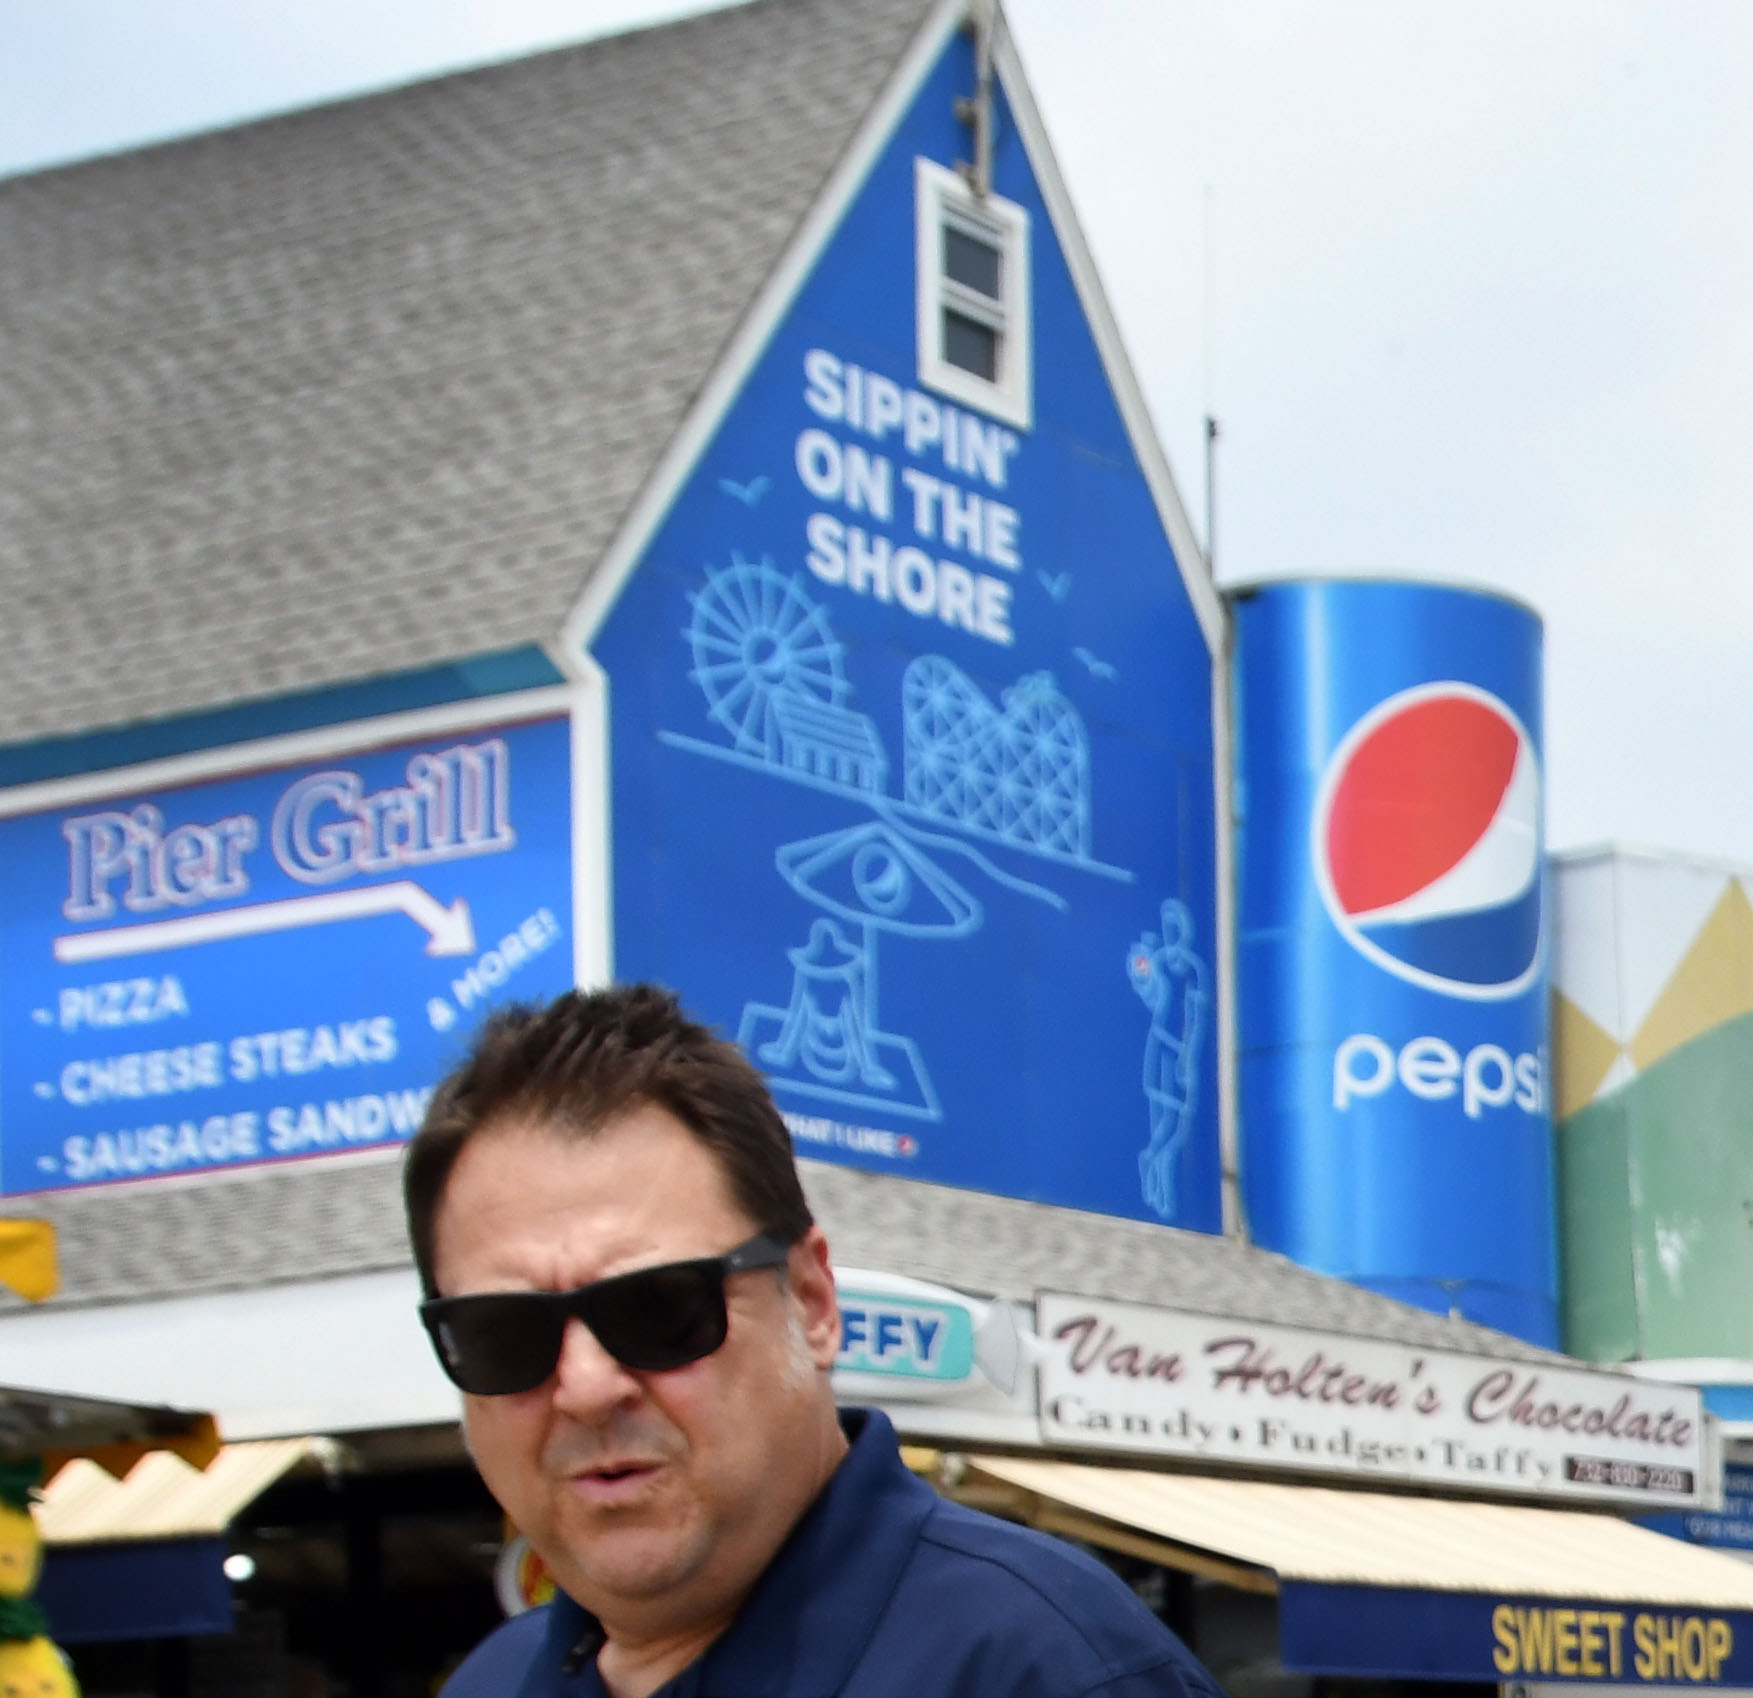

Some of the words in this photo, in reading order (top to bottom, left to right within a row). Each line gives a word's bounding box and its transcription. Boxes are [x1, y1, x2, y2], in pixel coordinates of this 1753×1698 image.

[803, 348, 1018, 488] SIPPIN'
[794, 428, 893, 521] ON
[902, 467, 1023, 571] THE
[805, 511, 1014, 646] SHORE
[62, 802, 259, 921] Pier
[271, 738, 516, 886] Grill
[58, 976, 189, 1031] PIZZA
[60, 1041, 224, 1107] CHEESE
[230, 1016, 398, 1081] STEAKS
[1332, 1033, 1542, 1119] peps
[64, 1110, 261, 1181] SAUSAGE
[268, 1087, 437, 1153] SANDW
[841, 1309, 942, 1361] FFY
[1055, 1315, 1185, 1383] Van
[1204, 1337, 1442, 1416] Holten's
[1465, 1369, 1693, 1449] Chocolate
[1047, 1395, 1216, 1446] Candy
[1257, 1418, 1407, 1464] Fudge
[1433, 1437, 1555, 1483] Taffy
[1492, 1604, 1625, 1677] SWEET
[1633, 1613, 1734, 1681] SHOP
